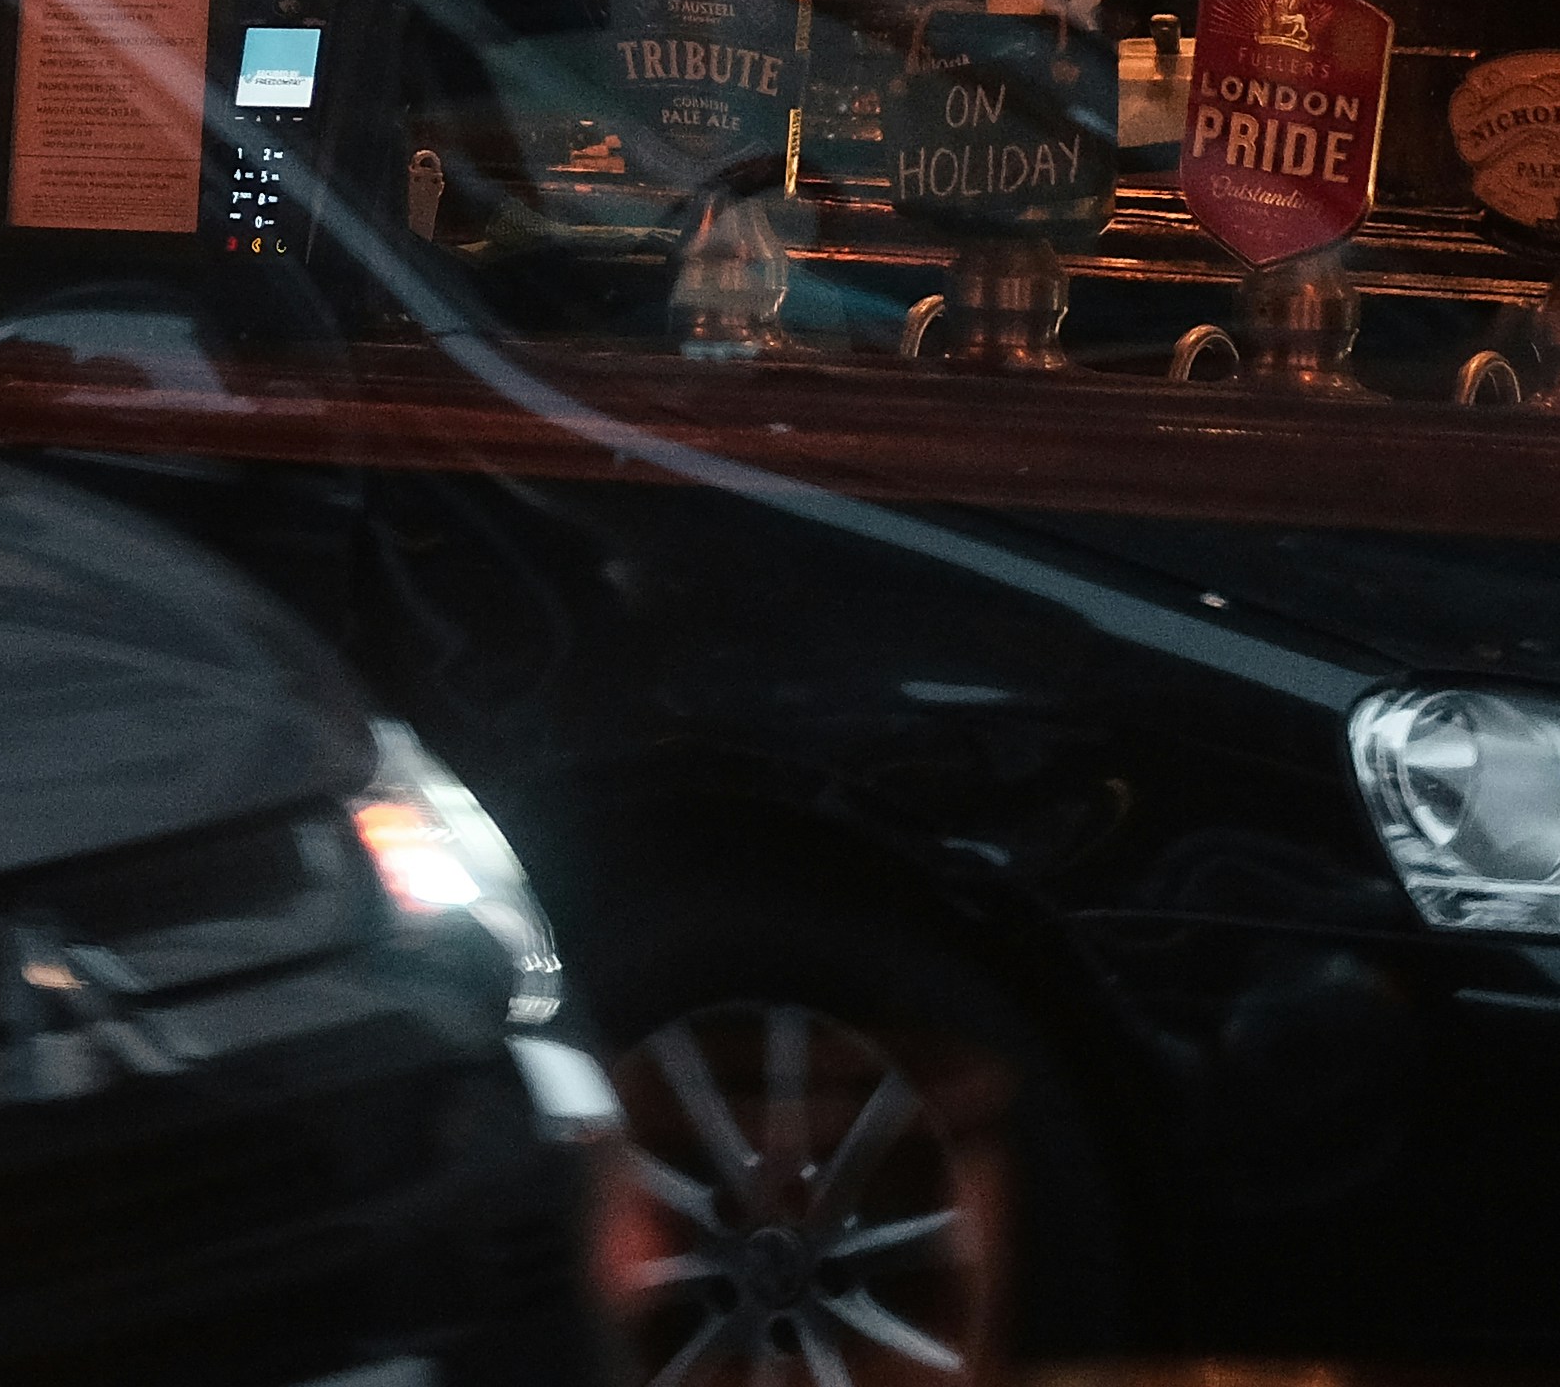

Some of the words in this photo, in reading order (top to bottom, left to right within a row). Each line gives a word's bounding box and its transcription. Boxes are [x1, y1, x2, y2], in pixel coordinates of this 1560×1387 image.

[615, 39, 786, 99] TRIBUTE
[1200, 69, 1361, 123] LONDON
[661, 109, 702, 129] PALE
[706, 112, 743, 133] ALE
[945, 82, 1008, 131] ON
[898, 134, 1083, 202] HOLIDAY
[1192, 105, 1356, 185] PRIDE
